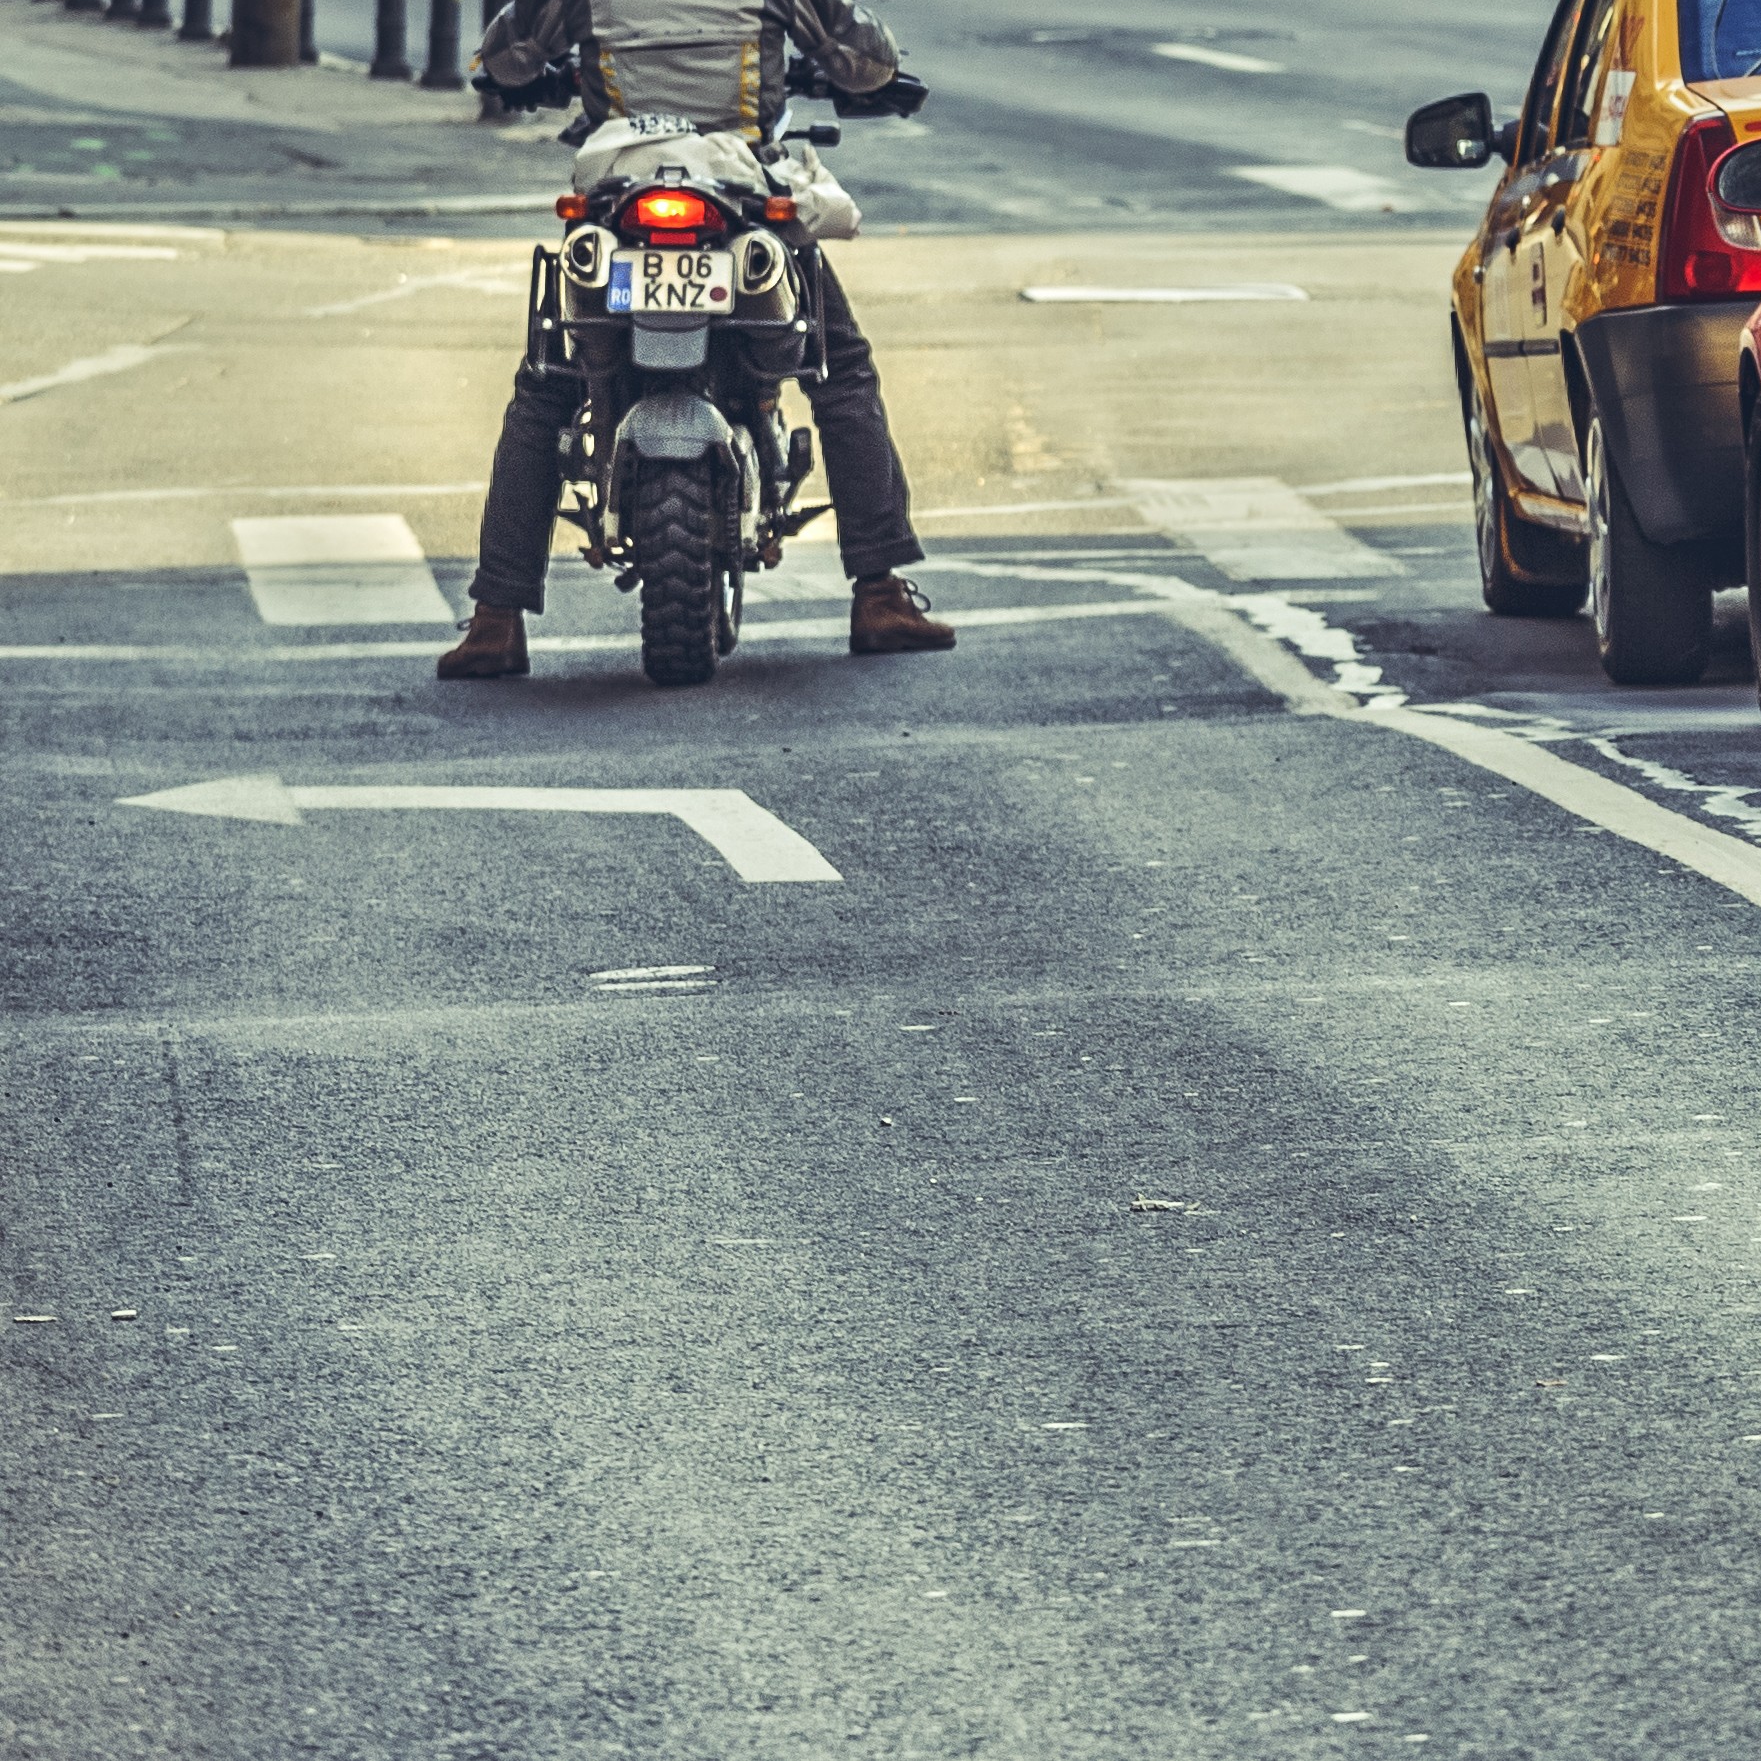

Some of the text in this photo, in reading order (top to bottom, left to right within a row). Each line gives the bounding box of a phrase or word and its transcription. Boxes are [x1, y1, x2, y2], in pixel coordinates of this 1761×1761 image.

[643, 252, 713, 279] B 06
[610, 287, 632, 306] RO
[644, 282, 706, 308] KNZ
